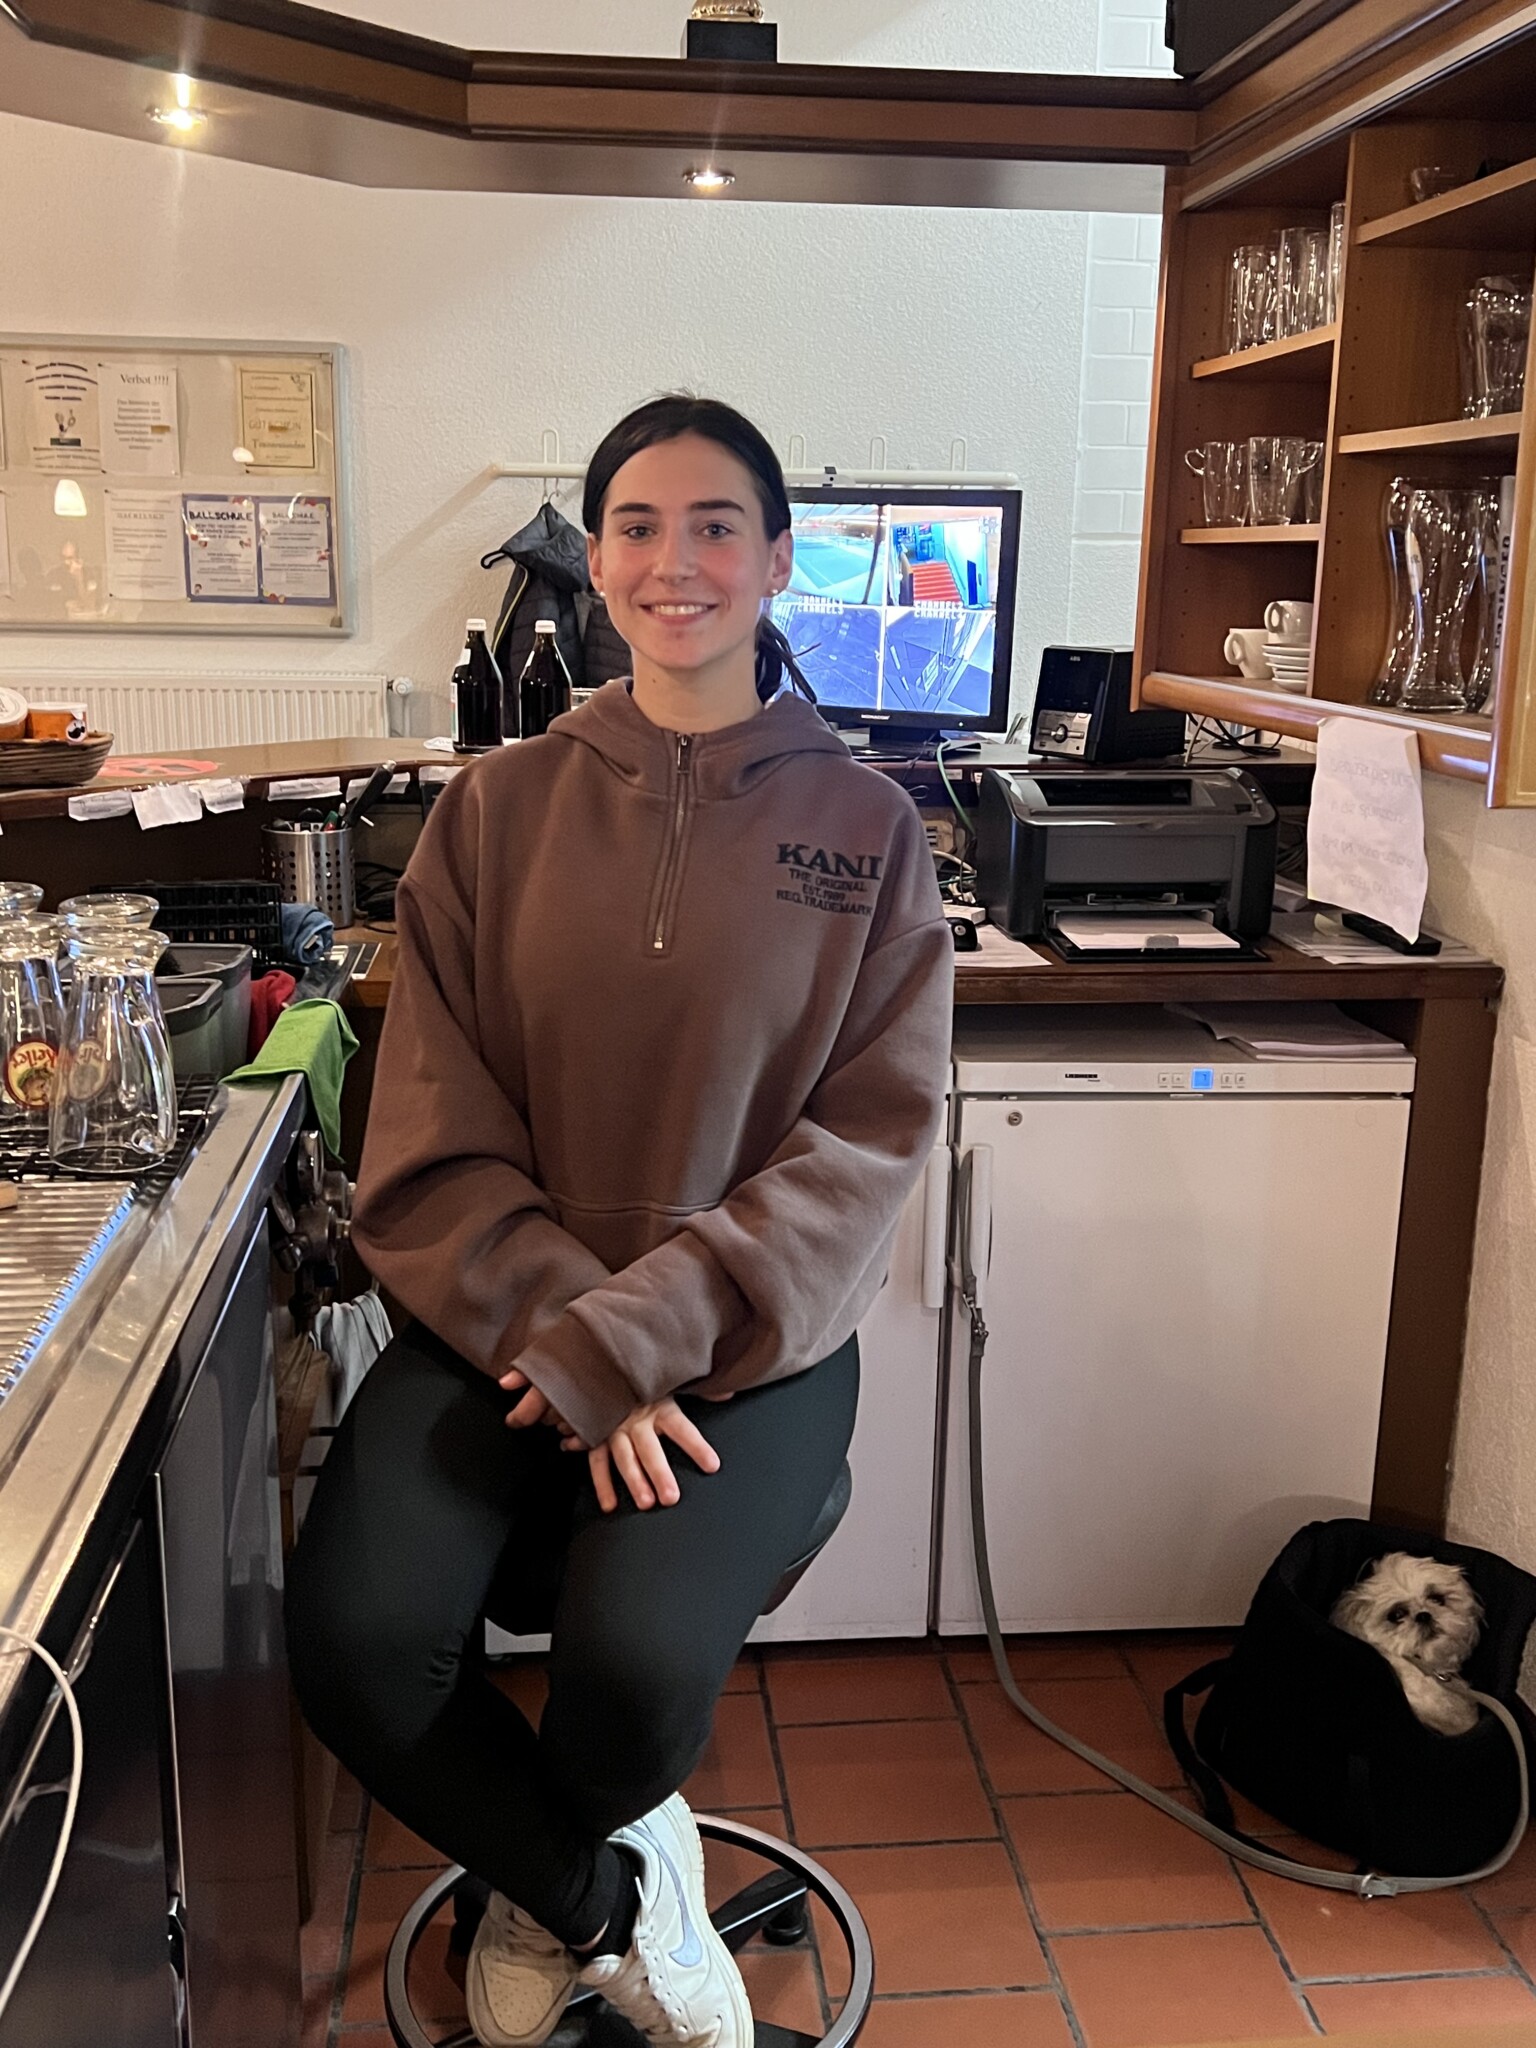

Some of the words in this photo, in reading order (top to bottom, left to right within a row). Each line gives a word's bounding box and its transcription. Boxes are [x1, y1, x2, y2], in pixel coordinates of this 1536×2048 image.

[120, 374, 151, 385] Verbot
[189, 510, 253, 521] BALLSCHULE
[775, 843, 883, 880] KANI
[789, 868, 811, 883] THE
[815, 876, 868, 892] ORIGINAL
[804, 895, 873, 915] TRADEMARK
